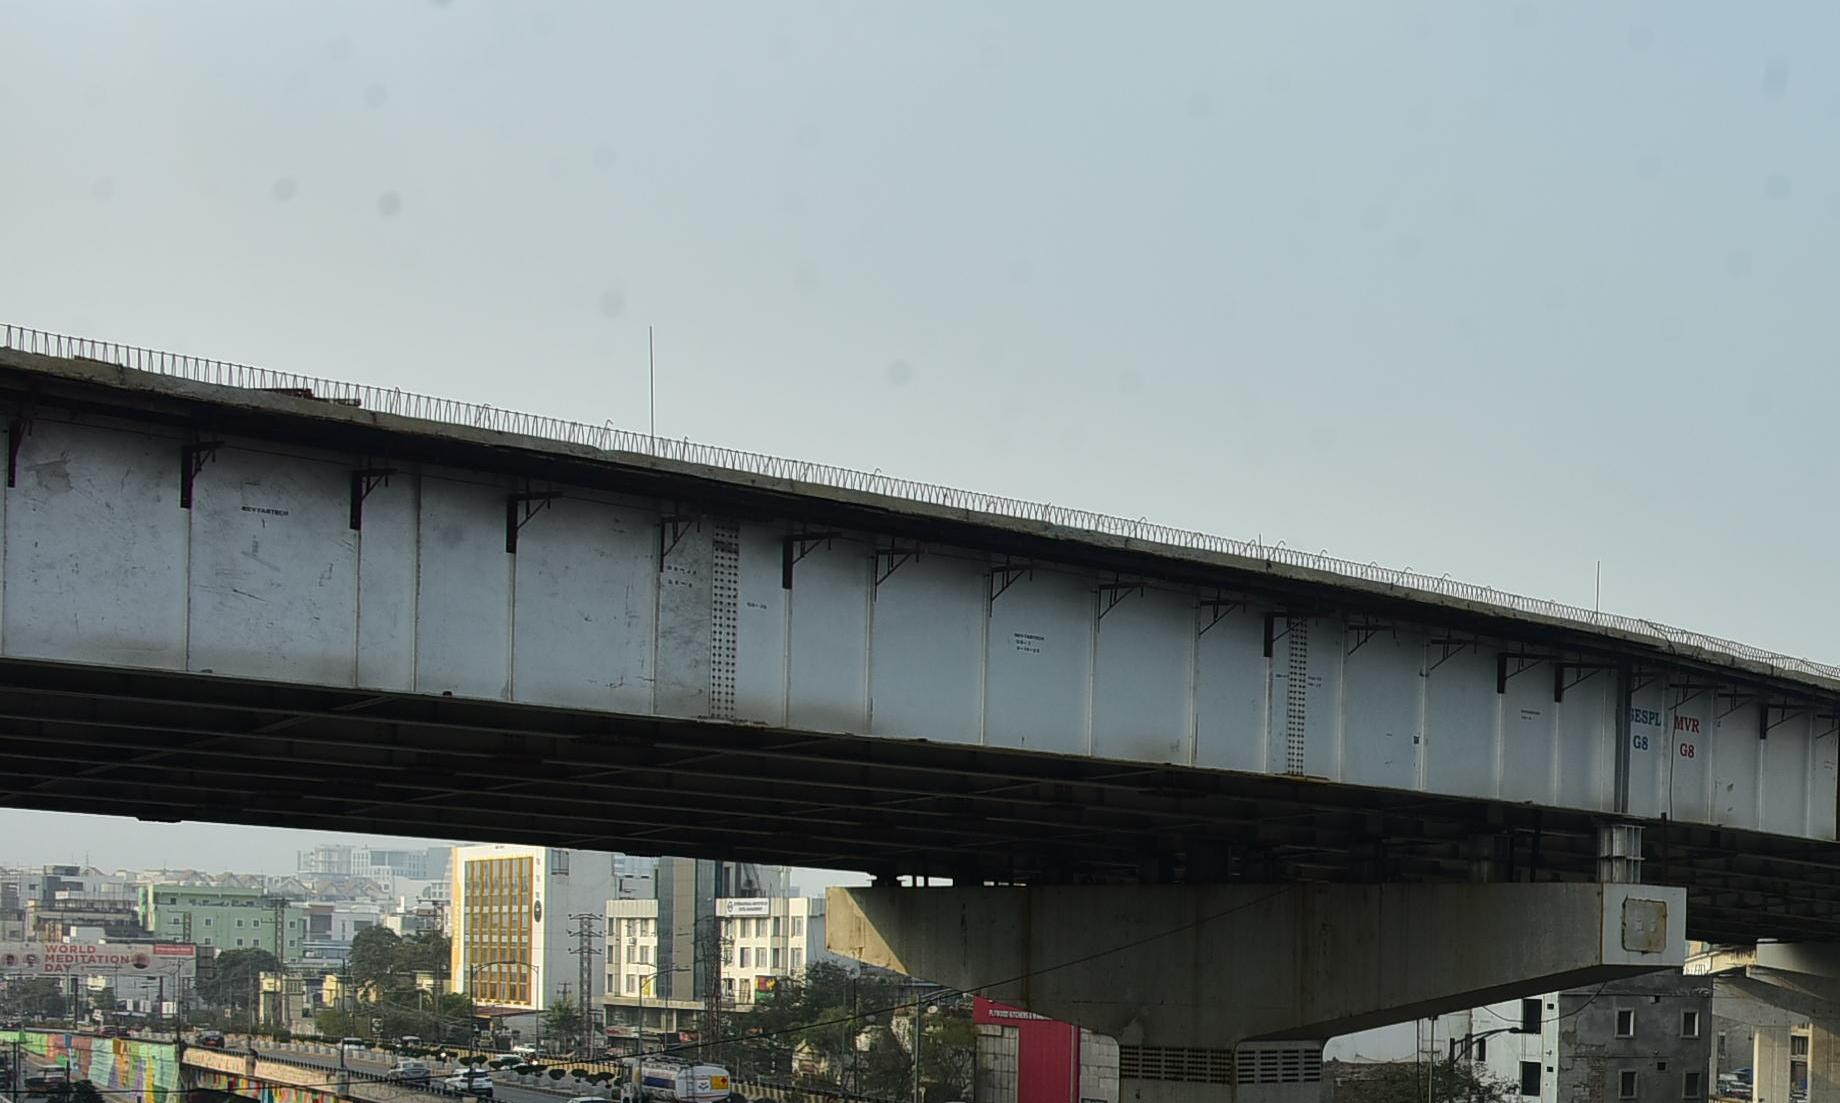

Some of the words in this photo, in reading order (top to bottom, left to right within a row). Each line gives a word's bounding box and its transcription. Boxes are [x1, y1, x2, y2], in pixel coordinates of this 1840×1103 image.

[1674, 715, 1700, 734] MVR
[1633, 735, 1649, 751] G8
[1680, 743, 1694, 758] G8
[45, 944, 96, 954] WORLD
[45, 954, 130, 964] MEDITATION
[45, 964, 71, 972] DAY
